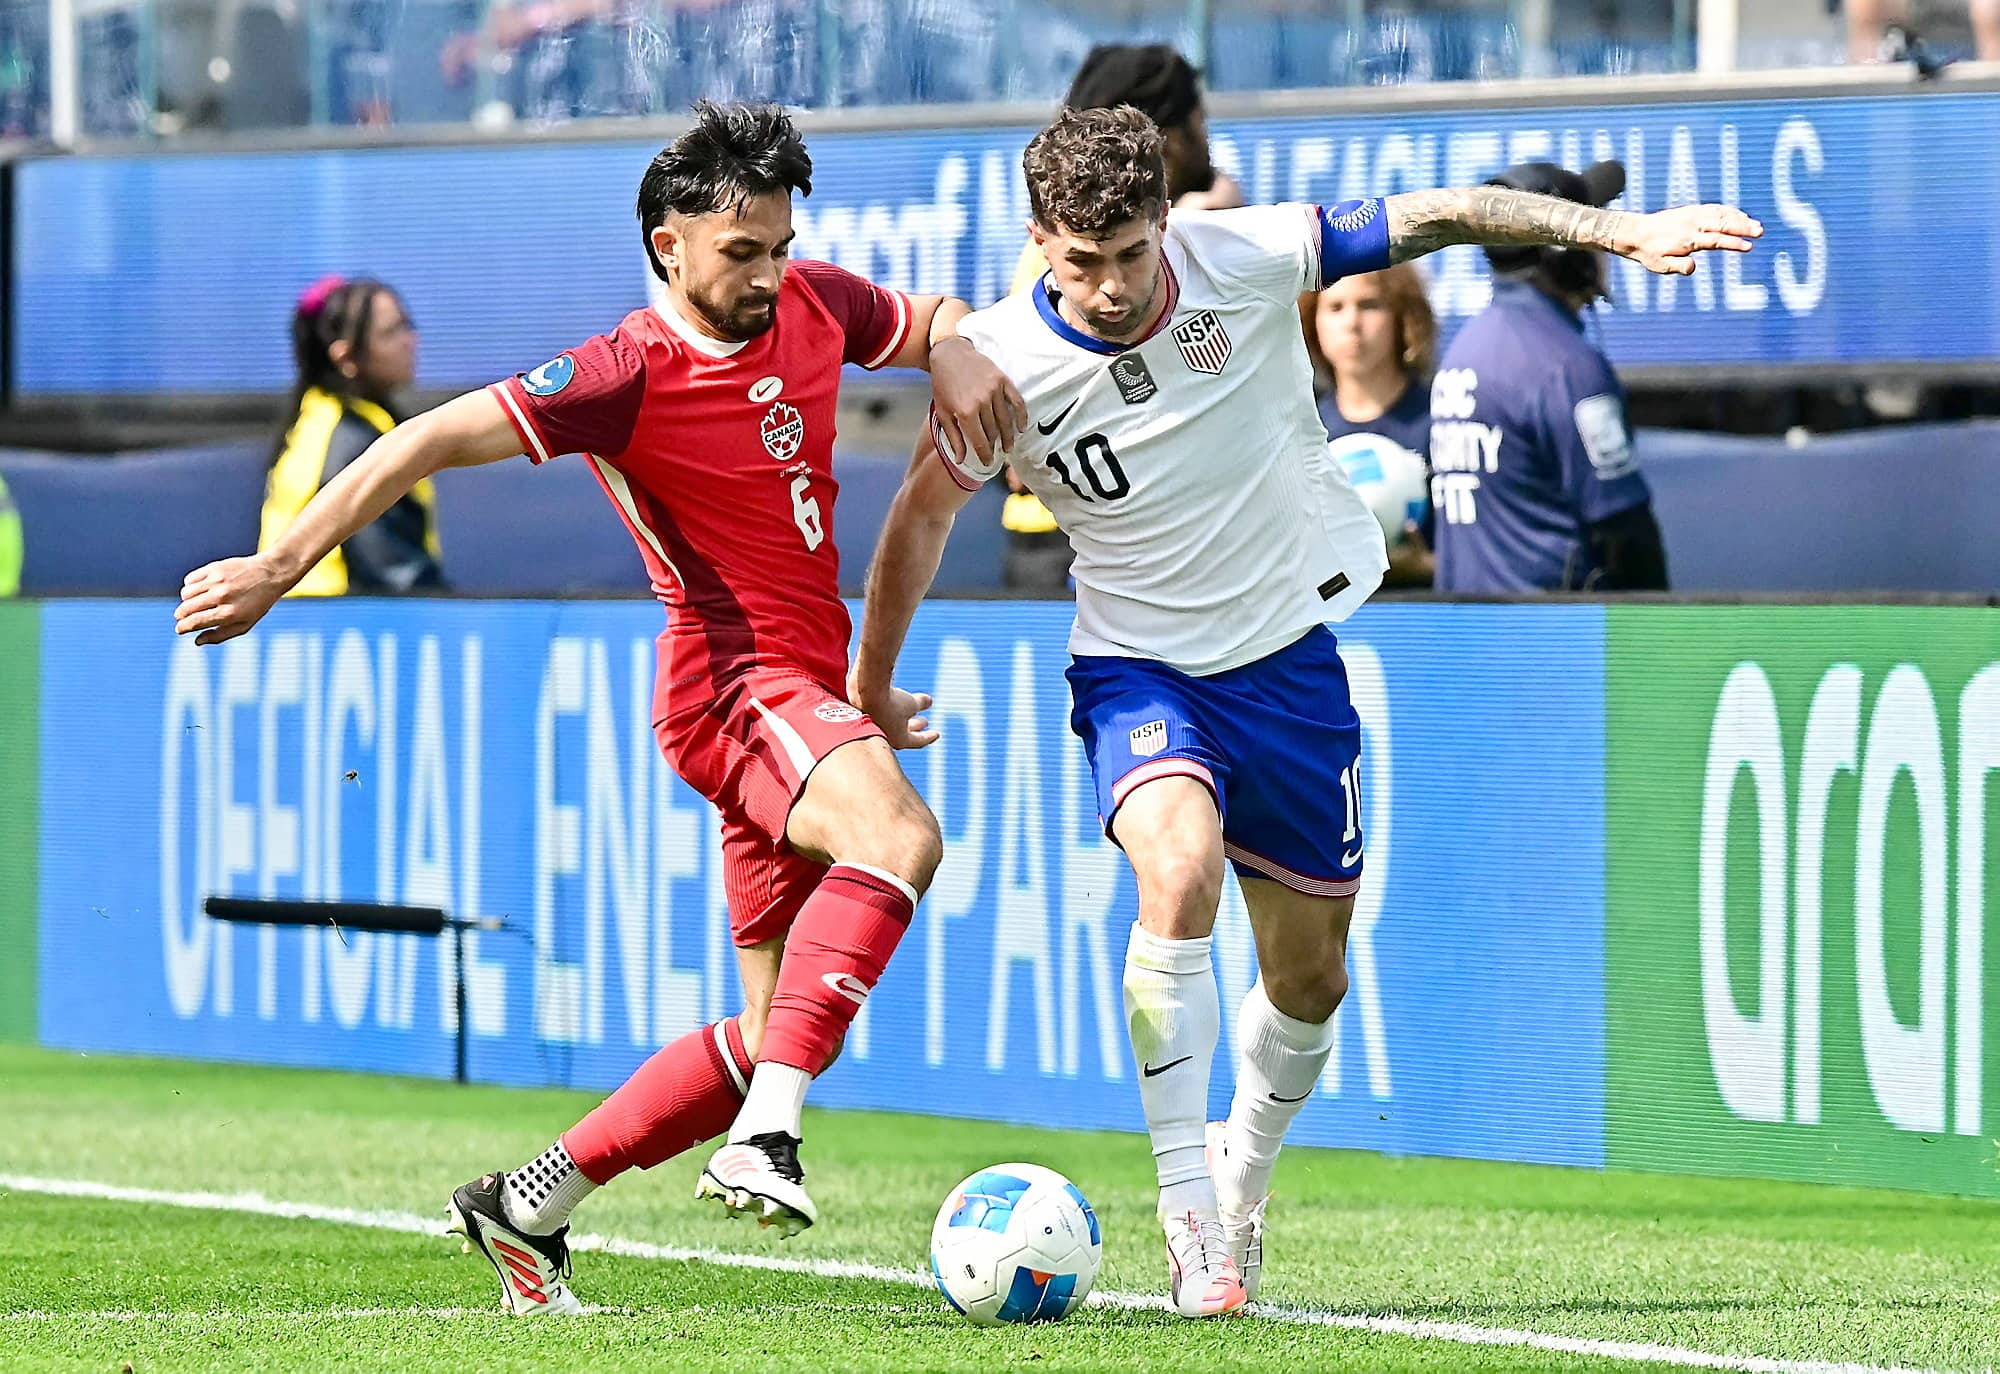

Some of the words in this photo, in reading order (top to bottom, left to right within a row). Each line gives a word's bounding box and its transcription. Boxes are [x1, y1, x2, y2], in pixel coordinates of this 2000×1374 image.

[1176, 311, 1216, 343] USA
[765, 420, 801, 443] CANADA
[1046, 433, 1130, 503] 10
[791, 475, 824, 552] 6
[1132, 722, 1163, 739] USA
[160, 628, 507, 1036] OFFICIAL
